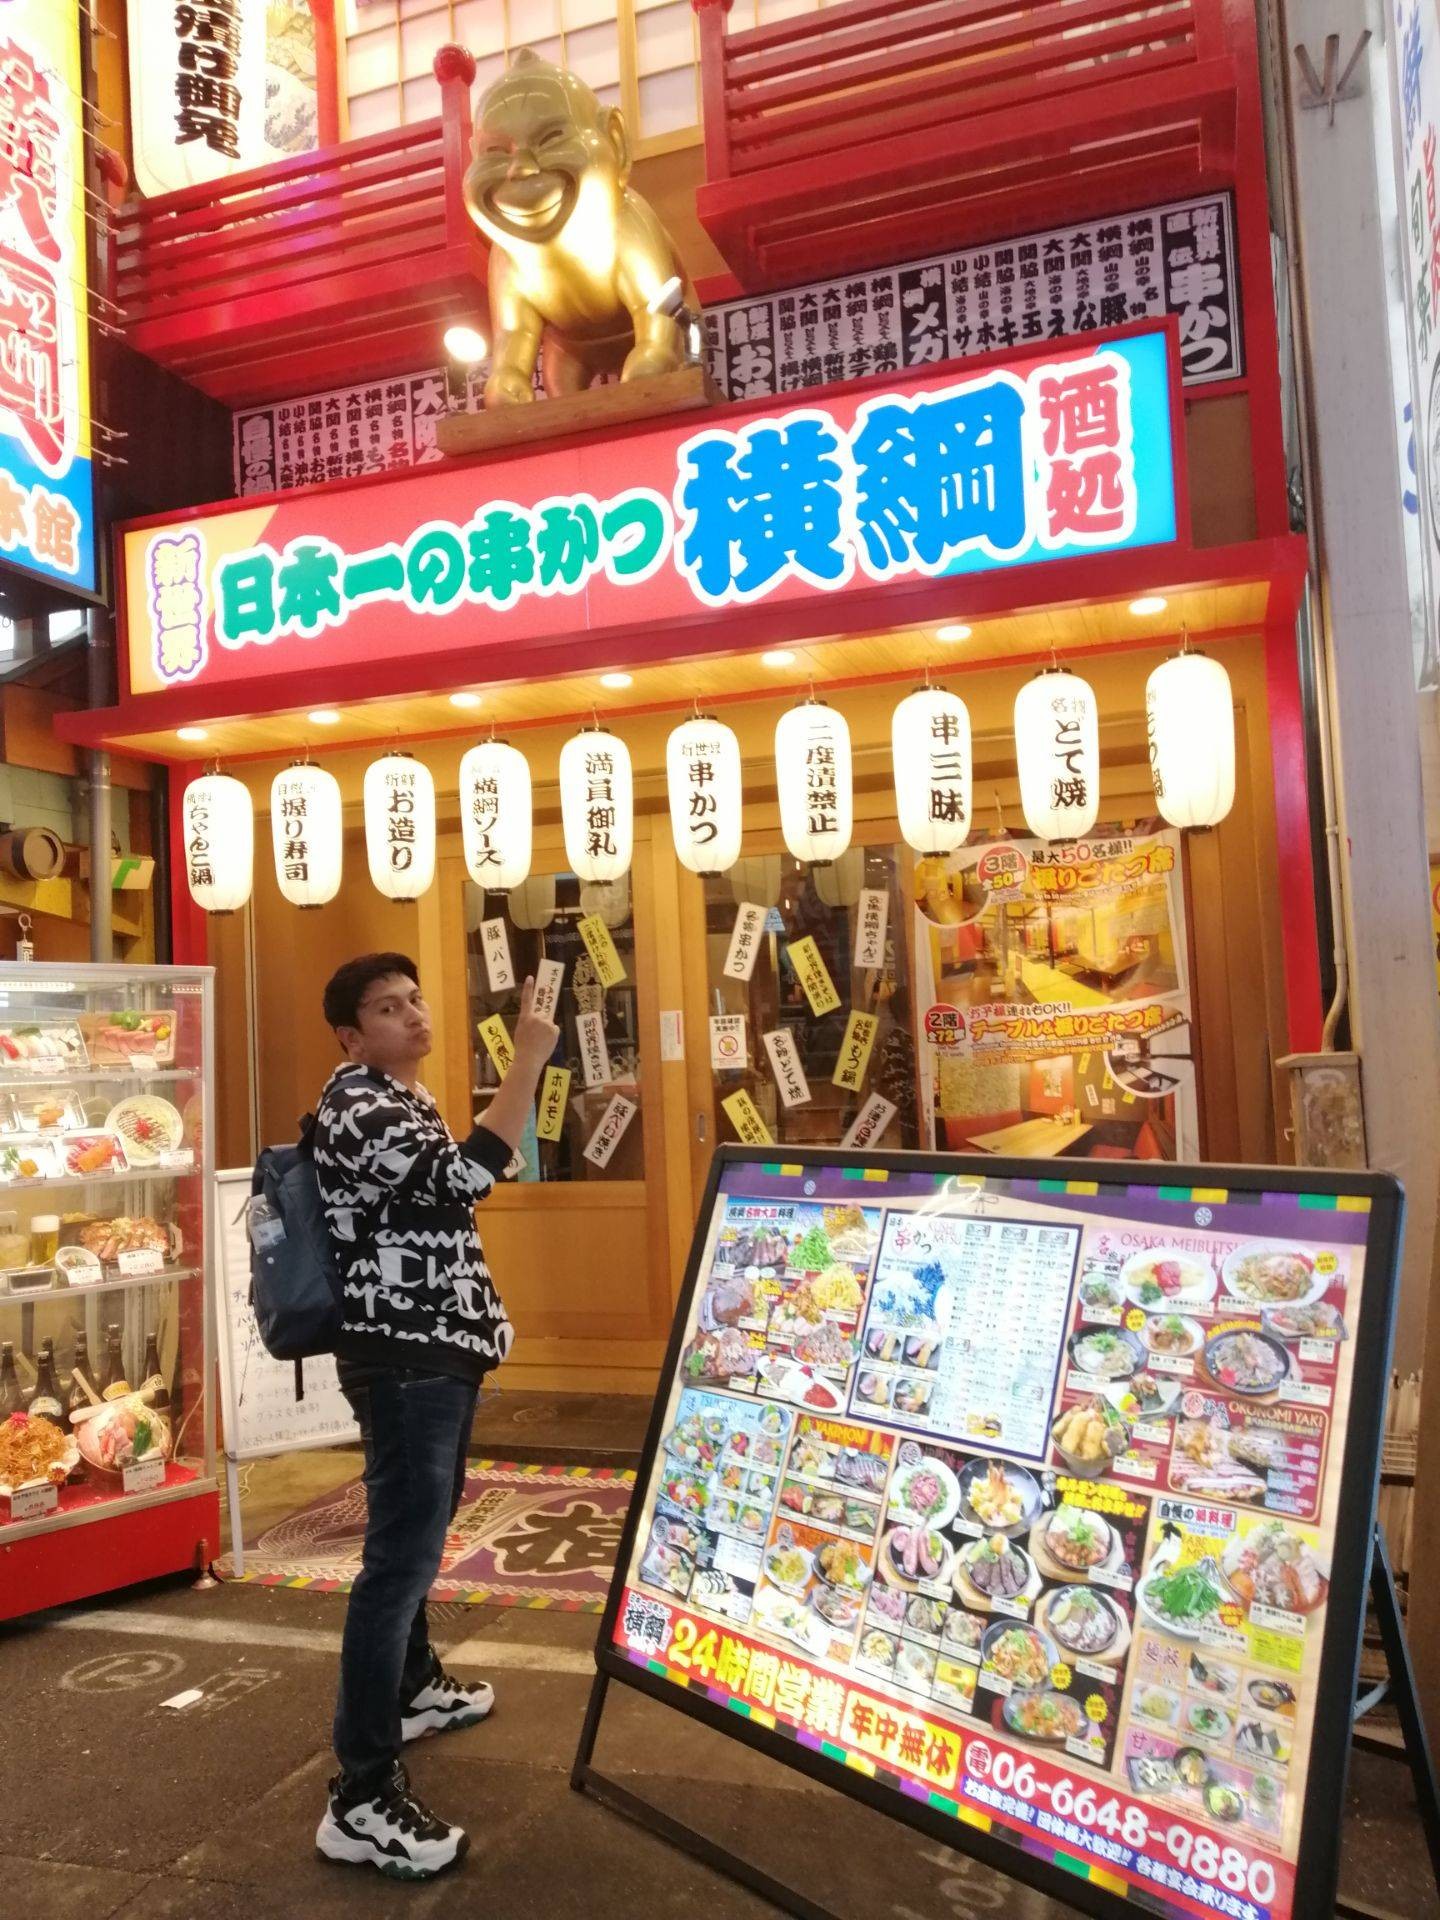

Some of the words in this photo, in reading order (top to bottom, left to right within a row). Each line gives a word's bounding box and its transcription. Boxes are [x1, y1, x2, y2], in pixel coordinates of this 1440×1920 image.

[1169, 262, 1228, 373] 串かつ
[683, 382, 1026, 597] 横綱
[1041, 364, 1123, 538] 酒処
[152, 533, 202, 674] 新世界
[220, 496, 665, 640] 日本一の串かつ
[584, 752, 617, 857] 満員御礼
[688, 760, 719, 843] 串かつ
[806, 724, 839, 836] 二度漬禁止
[1052, 717, 1087, 810] どて焼
[189, 806, 215, 887] ちゃんこ鍋
[281, 797, 308, 881] 握り寿司
[388, 789, 415, 871] お造り
[472, 778, 504, 868] 横綱ソース
[486, 925, 509, 984] 豚バラ
[928, 1012, 958, 1029] 2階
[543, 1073, 564, 1135] ホルモン
[1171, 1238, 1242, 1256] MEIBUTS
[668, 1617, 846, 1738] 24時間営業
[850, 1698, 954, 1779] 年中無休
[991, 1752, 1277, 1905] 06-6648-9880
